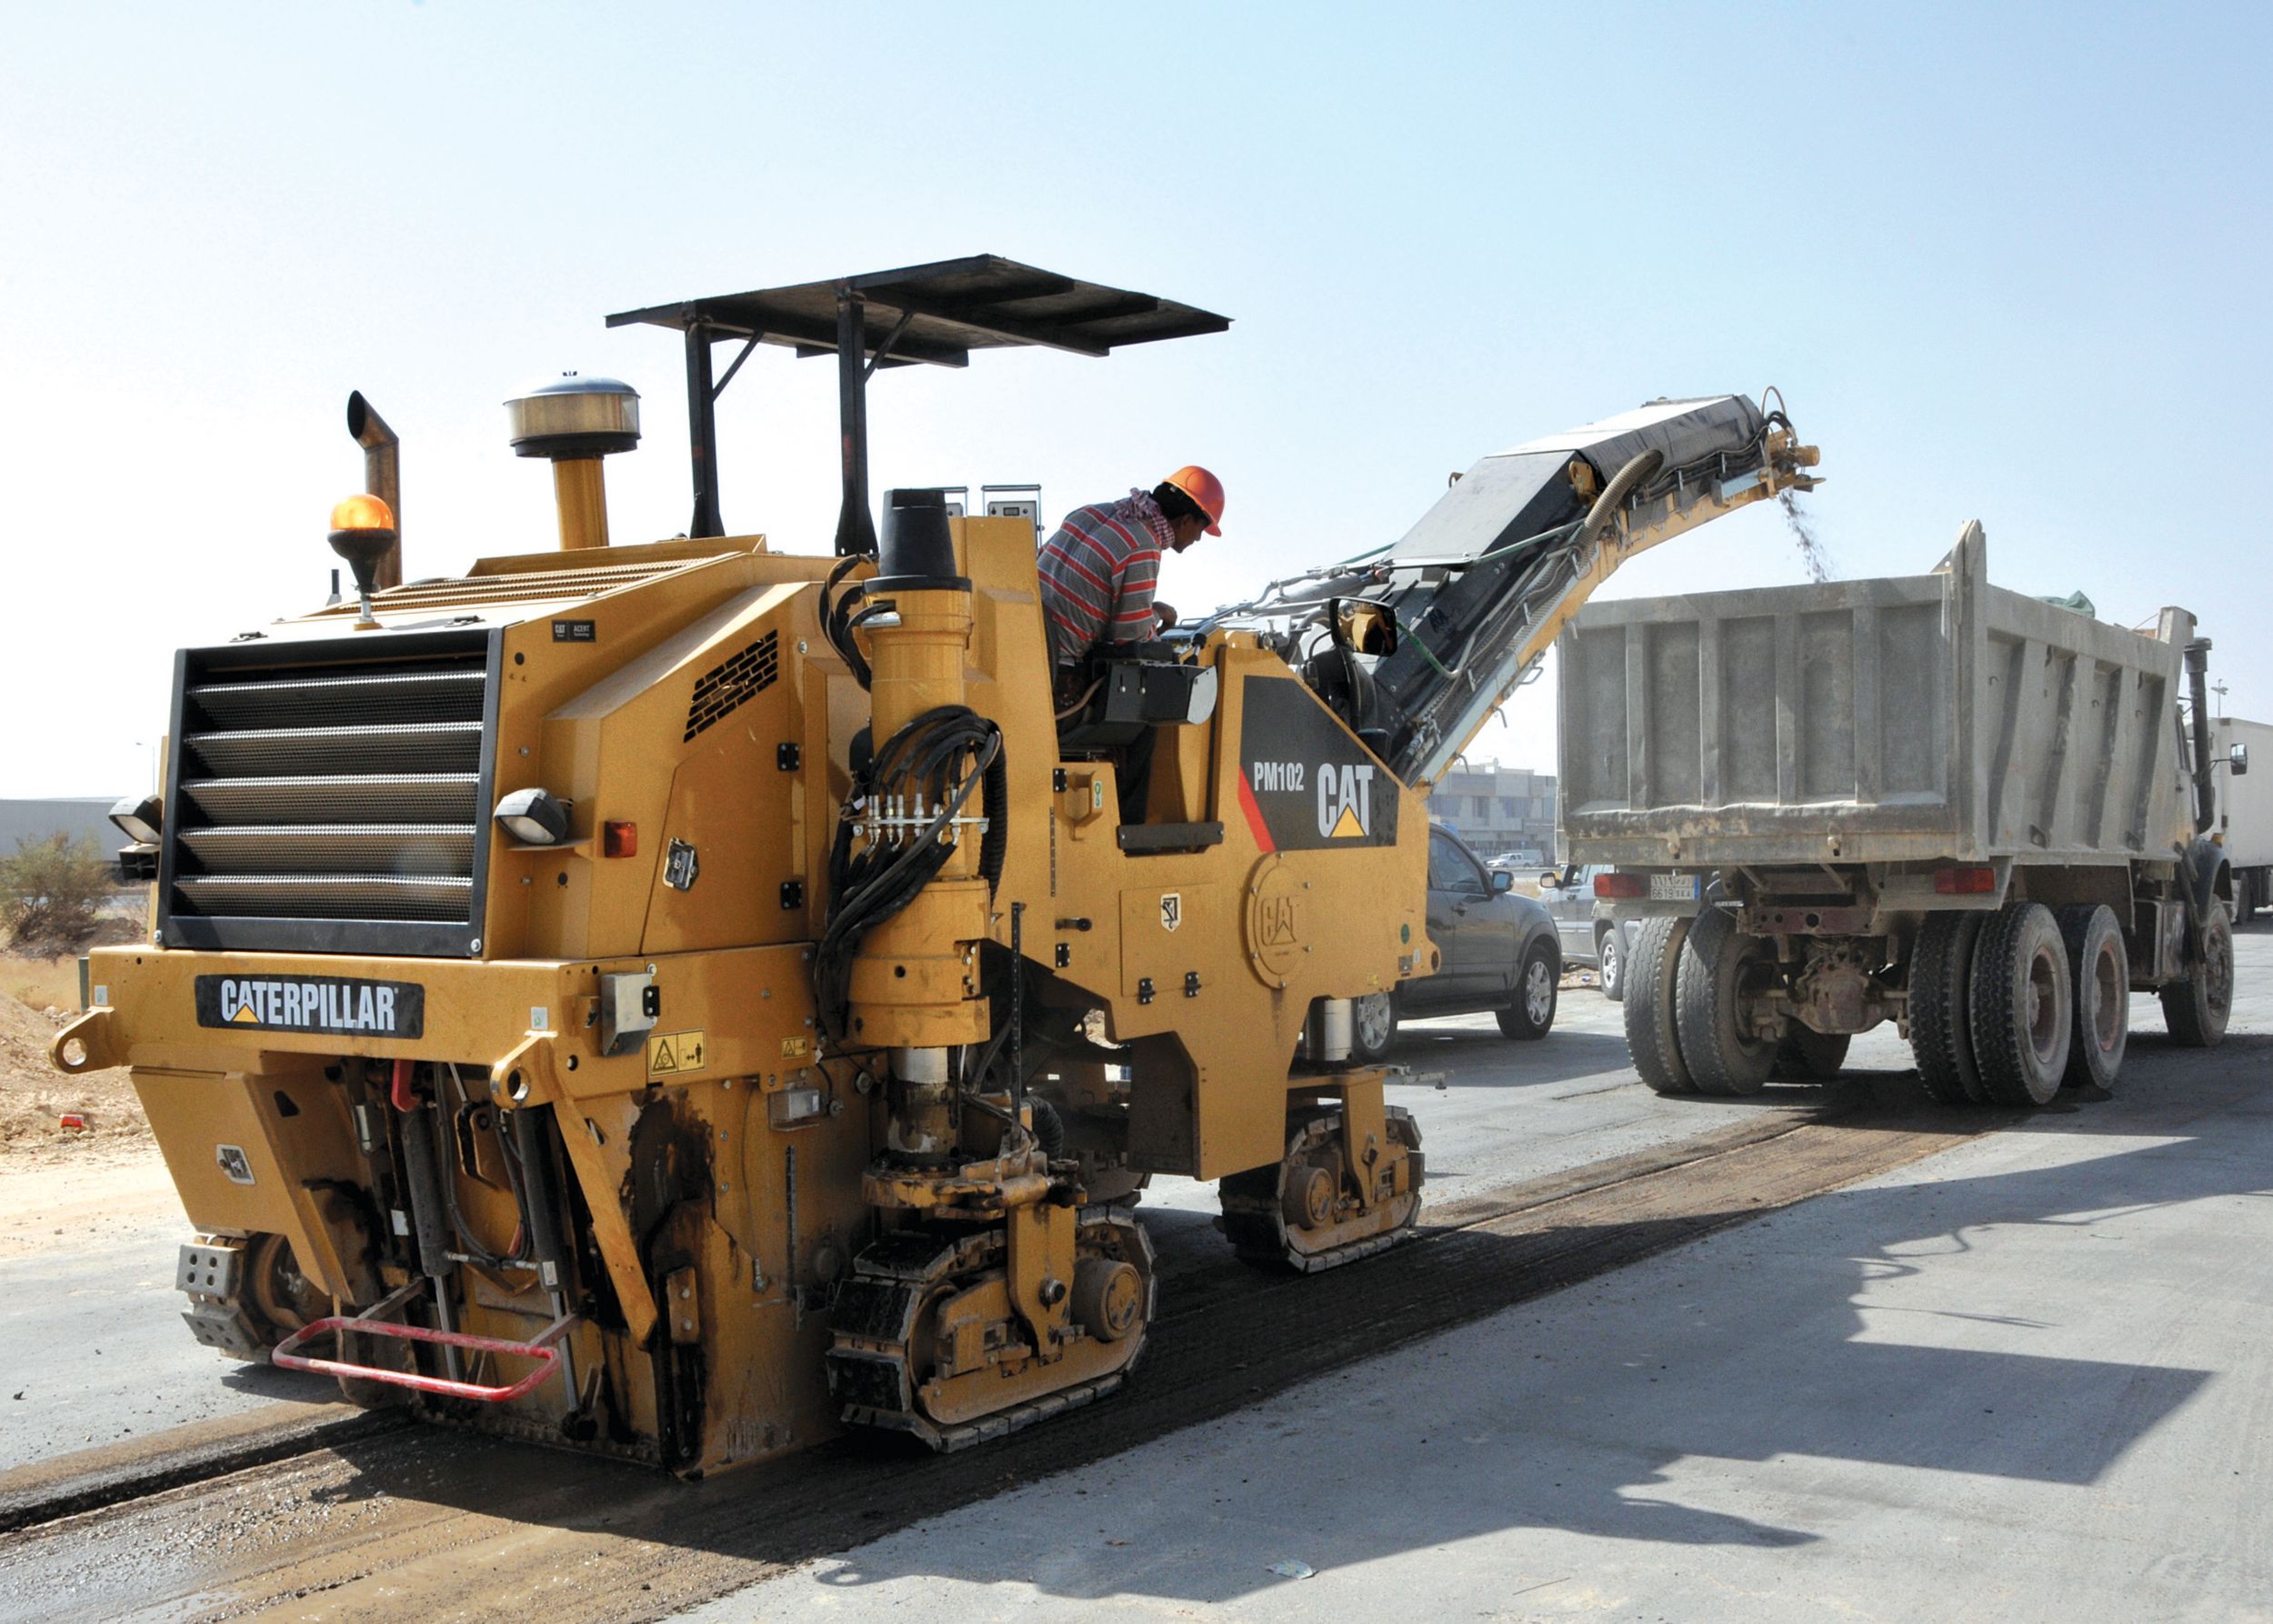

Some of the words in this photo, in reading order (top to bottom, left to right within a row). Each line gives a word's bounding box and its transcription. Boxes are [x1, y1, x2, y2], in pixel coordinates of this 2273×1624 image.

[1254, 762, 1304, 791] PM102
[1318, 763, 1374, 837] CAT
[1652, 888, 1673, 898] 6619
[1261, 897, 1298, 946] CAT
[221, 979, 396, 1031] CATERPILLAR
